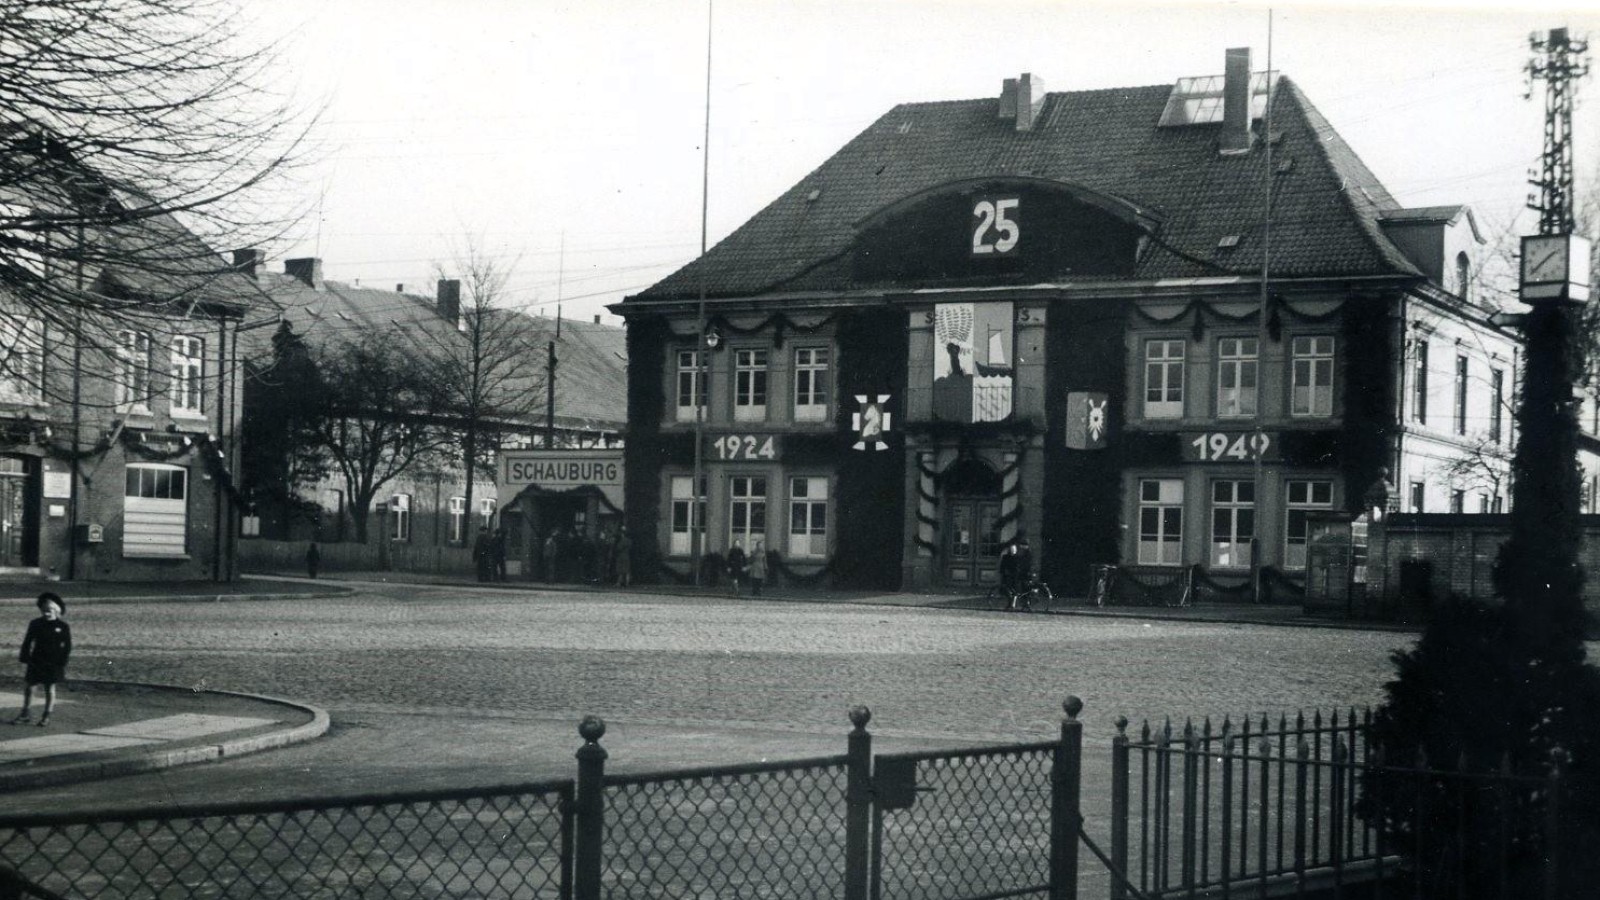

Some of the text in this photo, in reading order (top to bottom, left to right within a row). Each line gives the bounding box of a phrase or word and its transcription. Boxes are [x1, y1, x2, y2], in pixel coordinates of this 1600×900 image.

[972, 199, 1020, 253] 25
[713, 435, 775, 460] 1924
[1192, 433, 1270, 461] 1949
[513, 462, 617, 480] SCHAUBURG
